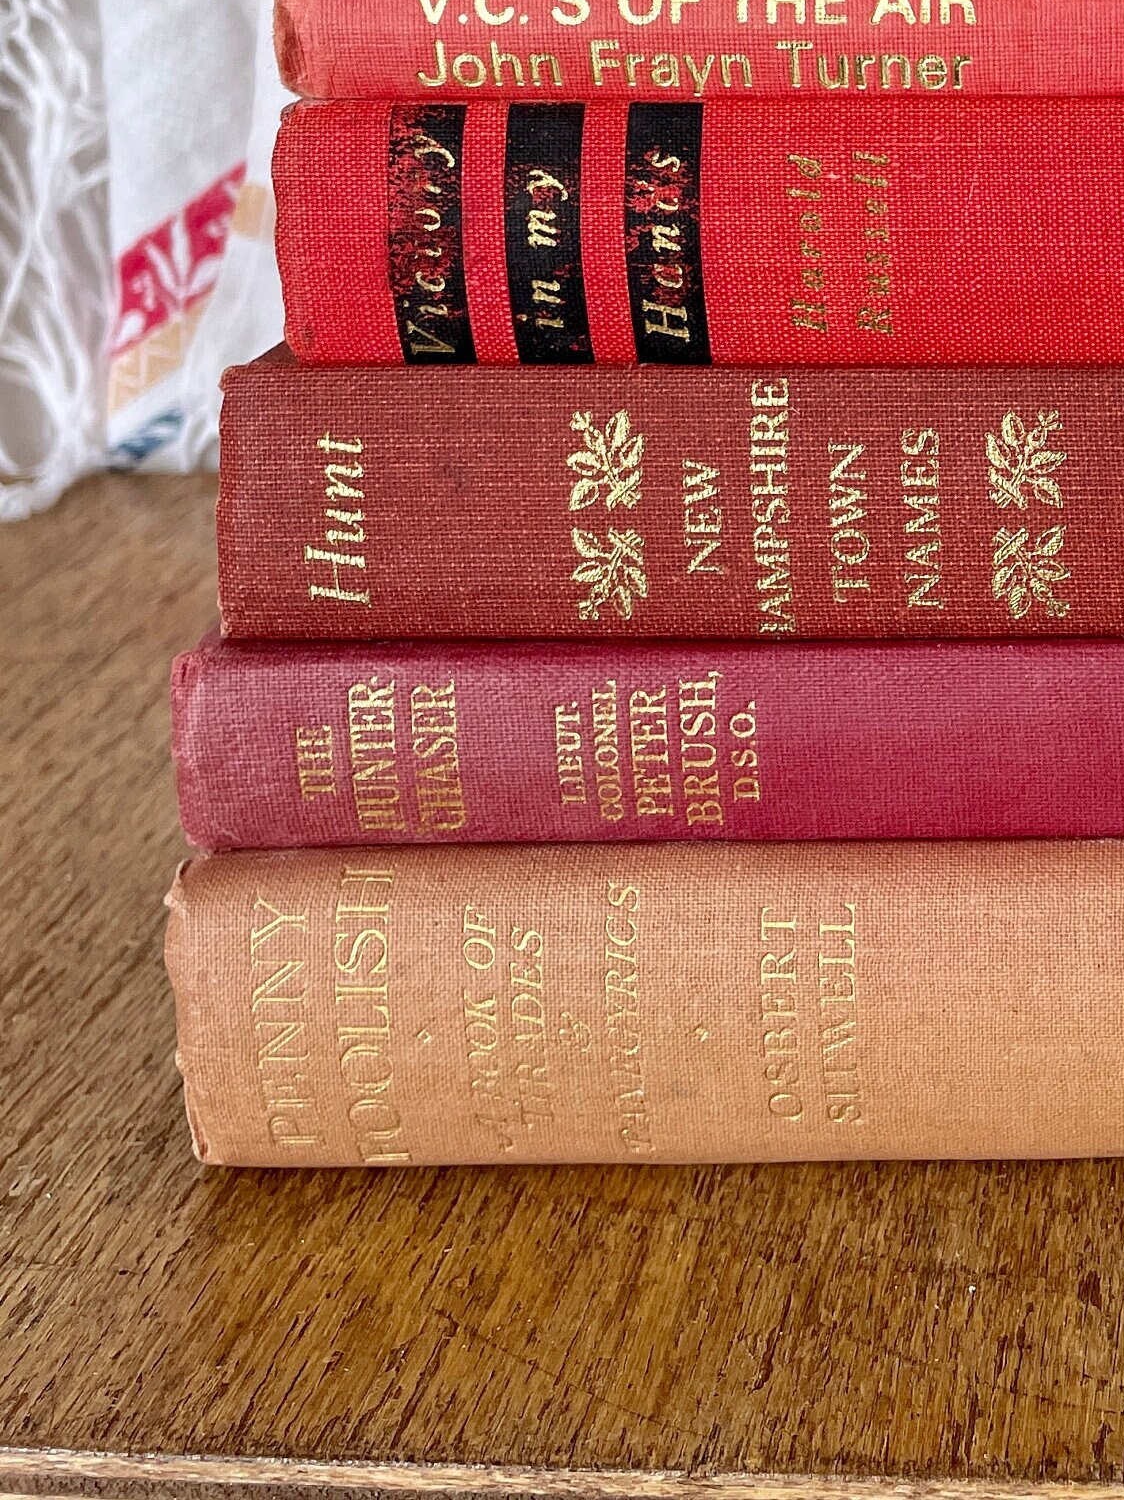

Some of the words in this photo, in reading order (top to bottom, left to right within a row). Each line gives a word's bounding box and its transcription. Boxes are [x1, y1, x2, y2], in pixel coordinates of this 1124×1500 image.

[416, 40, 562, 88] John
[590, 39, 753, 97] Frayn
[775, 40, 973, 90] Turner
[527, 169, 568, 247] my
[786, 153, 828, 332] Harold
[852, 151, 893, 335] Russell
[517, 279, 565, 328] in
[304, 431, 372, 608] Hunt
[682, 459, 724, 574] NEW
[828, 439, 871, 603] TOWN
[901, 428, 944, 609] NAMES
[296, 725, 336, 800] THE
[411, 682, 466, 833] CHASER
[592, 680, 624, 821] COLONEL
[630, 685, 674, 816] PETER
[679, 671, 724, 826] BRUSH,
[730, 702, 761, 802] D.S.O.
[462, 904, 496, 970] OF
[818, 902, 862, 1124] SITWELL
[251, 888, 325, 1148] PENNY
[334, 866, 413, 1164] FOOLISH
[760, 906, 803, 1122] OSBERT
